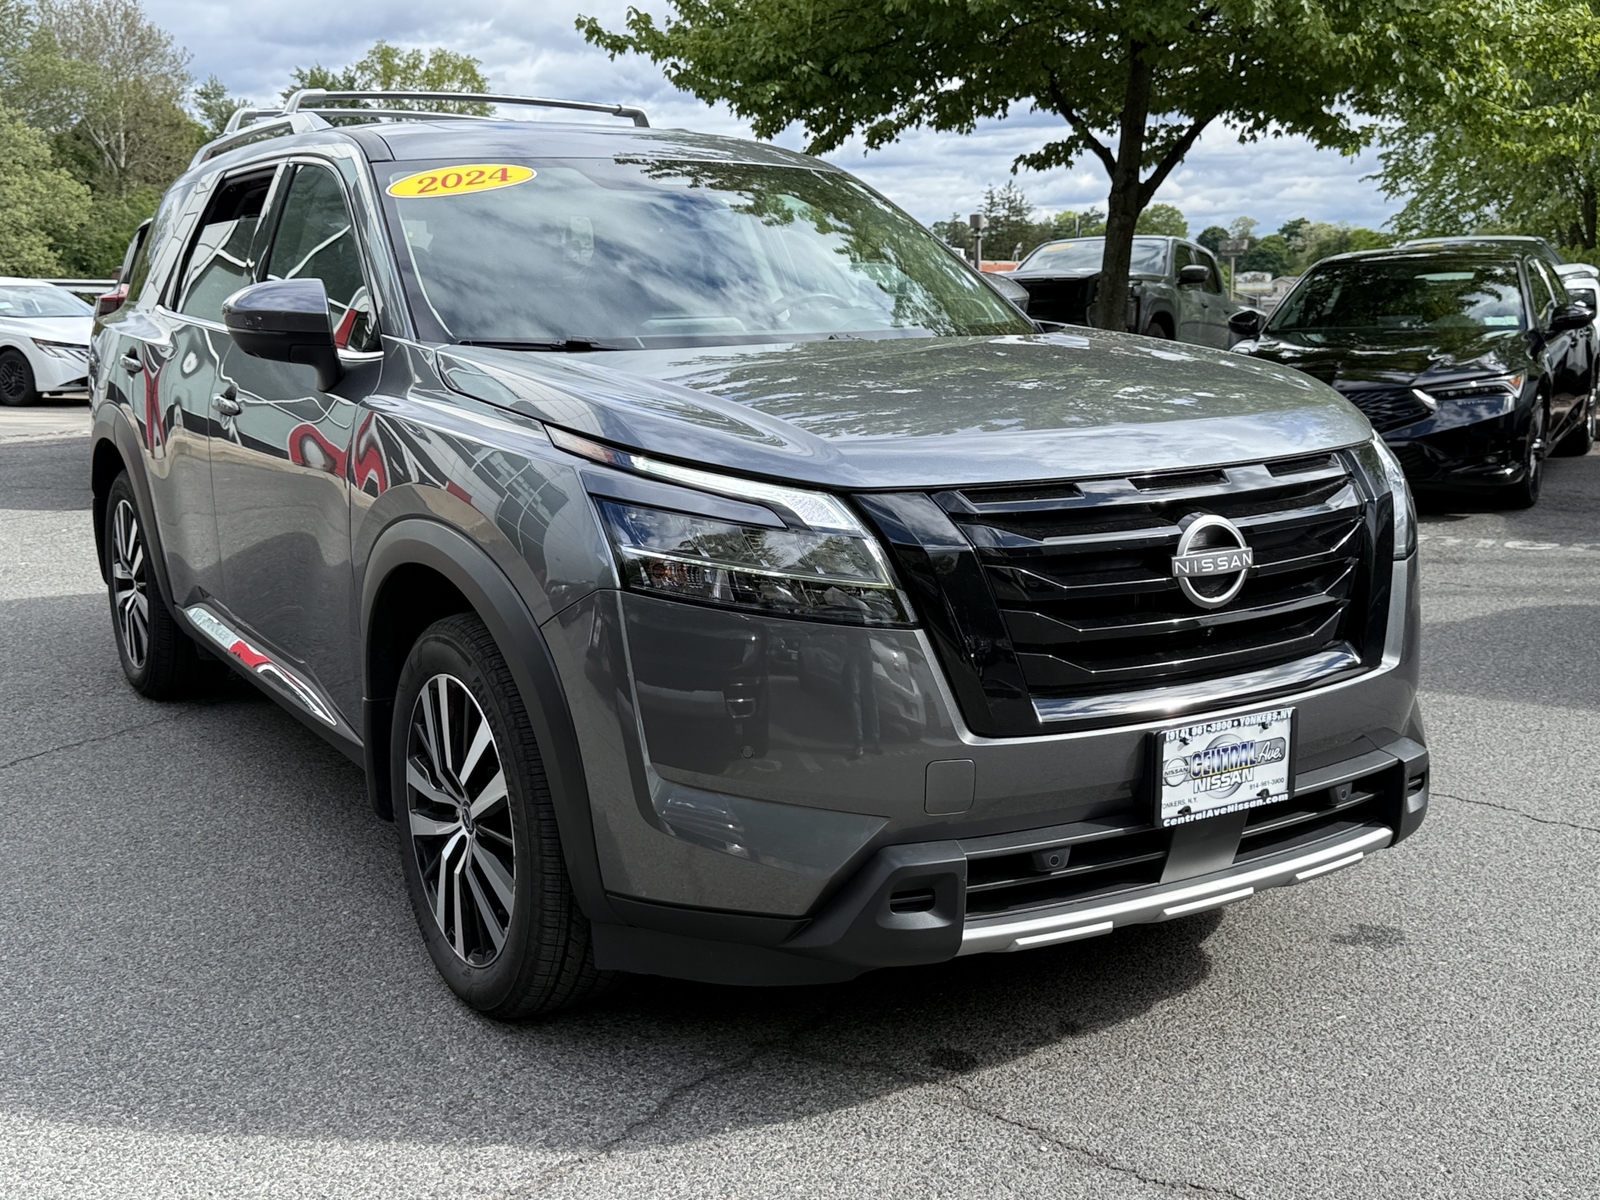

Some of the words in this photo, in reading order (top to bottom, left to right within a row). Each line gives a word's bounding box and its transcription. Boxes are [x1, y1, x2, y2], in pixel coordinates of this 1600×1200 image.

[417, 167, 513, 194] 2024
[1174, 551, 1252, 575] NISSAN
[1164, 766, 1189, 777] NISSAN
[1190, 740, 1257, 780] CENTRAL
[1257, 740, 1283, 763] Ave.
[1193, 767, 1255, 794] NISSAN
[1162, 798, 1187, 810] ONKERS,
